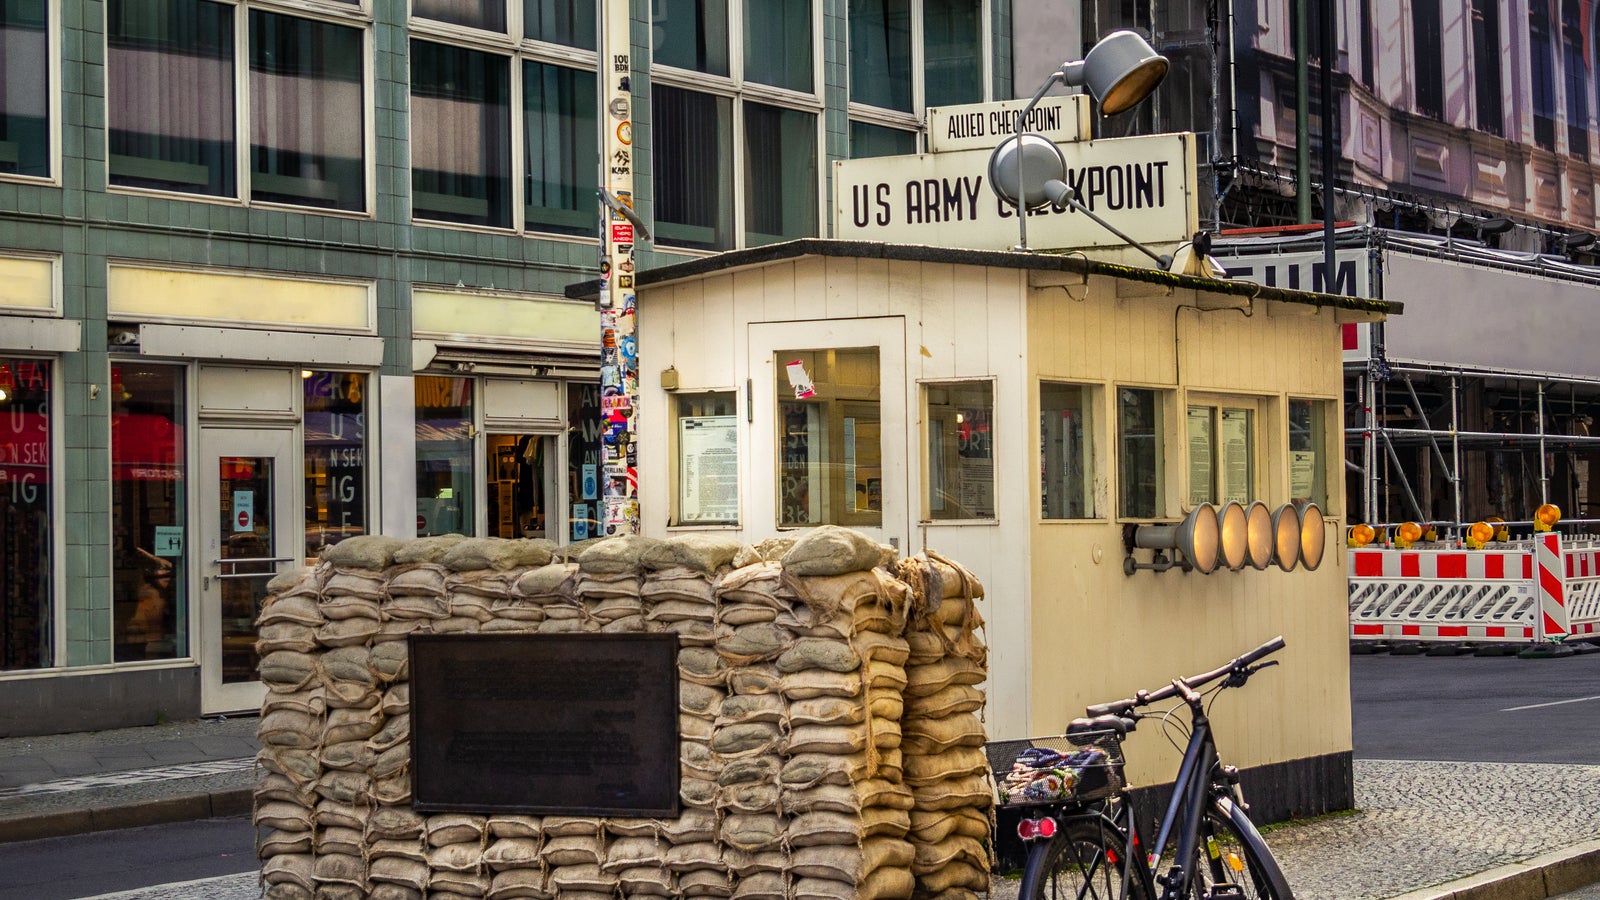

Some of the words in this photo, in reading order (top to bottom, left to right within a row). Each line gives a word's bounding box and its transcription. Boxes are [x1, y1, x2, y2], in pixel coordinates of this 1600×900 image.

[948, 112, 985, 139] ALLIED
[906, 175, 983, 225] ARMY
[997, 160, 1169, 219] KPOINT
